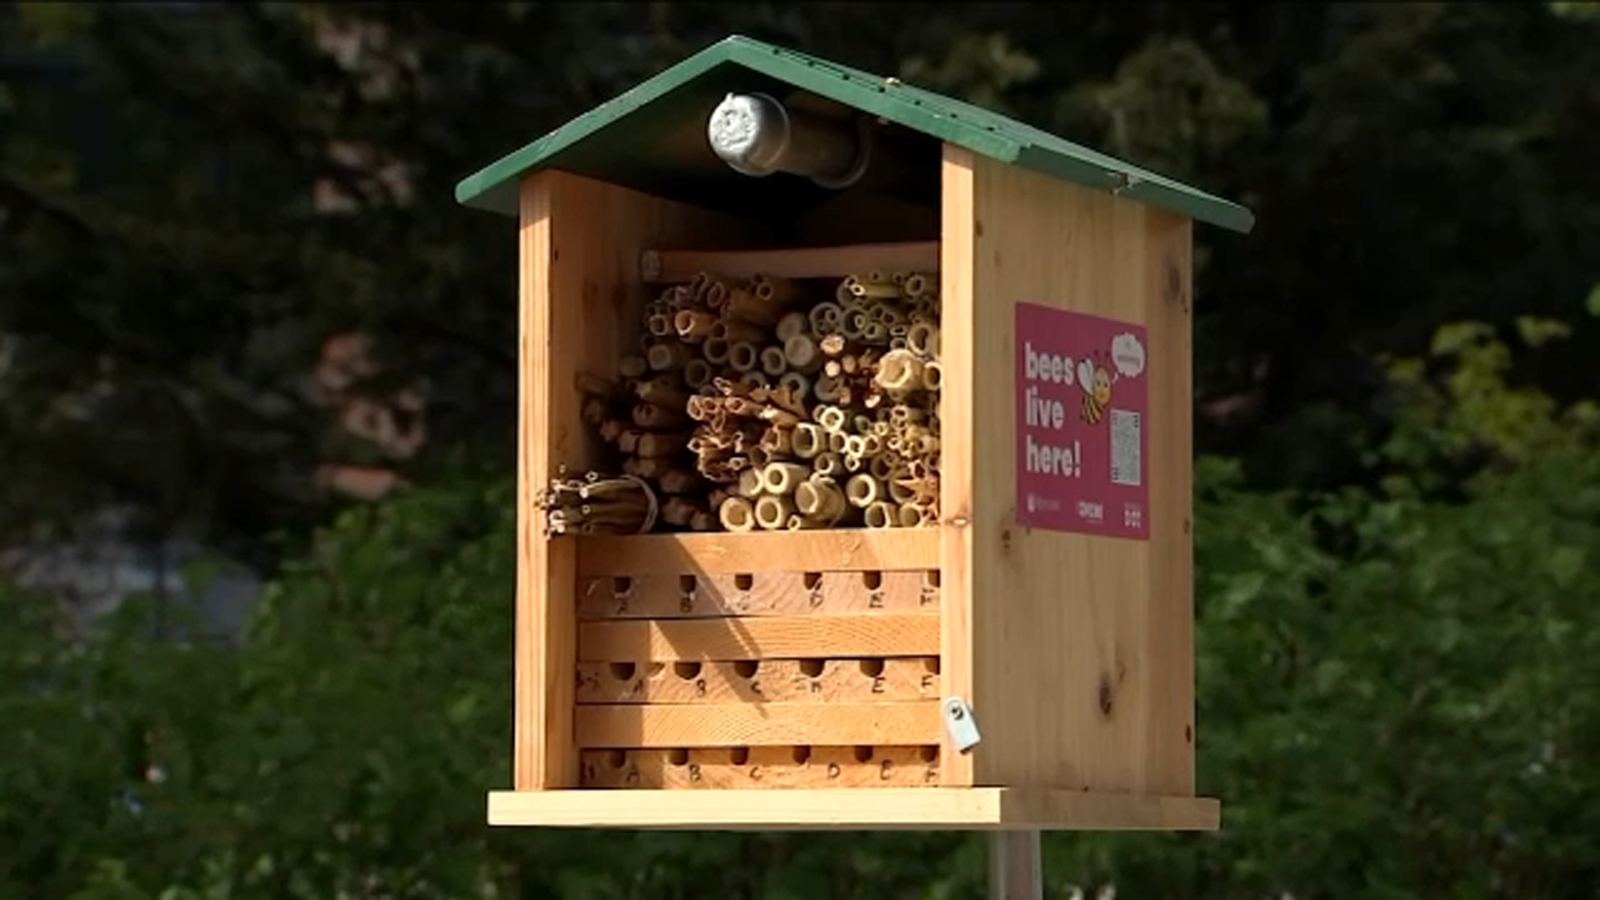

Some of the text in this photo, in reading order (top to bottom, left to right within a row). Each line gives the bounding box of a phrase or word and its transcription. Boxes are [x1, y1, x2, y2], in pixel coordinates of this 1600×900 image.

[1024, 341, 1074, 386] bees
[1025, 386, 1064, 430] live
[1026, 434, 1081, 478] here!
[871, 677, 886, 694] E
[920, 675, 933, 687] F
[688, 764, 701, 782] B
[750, 766, 763, 780] C
[828, 763, 842, 779] D
[879, 760, 893, 780] E
